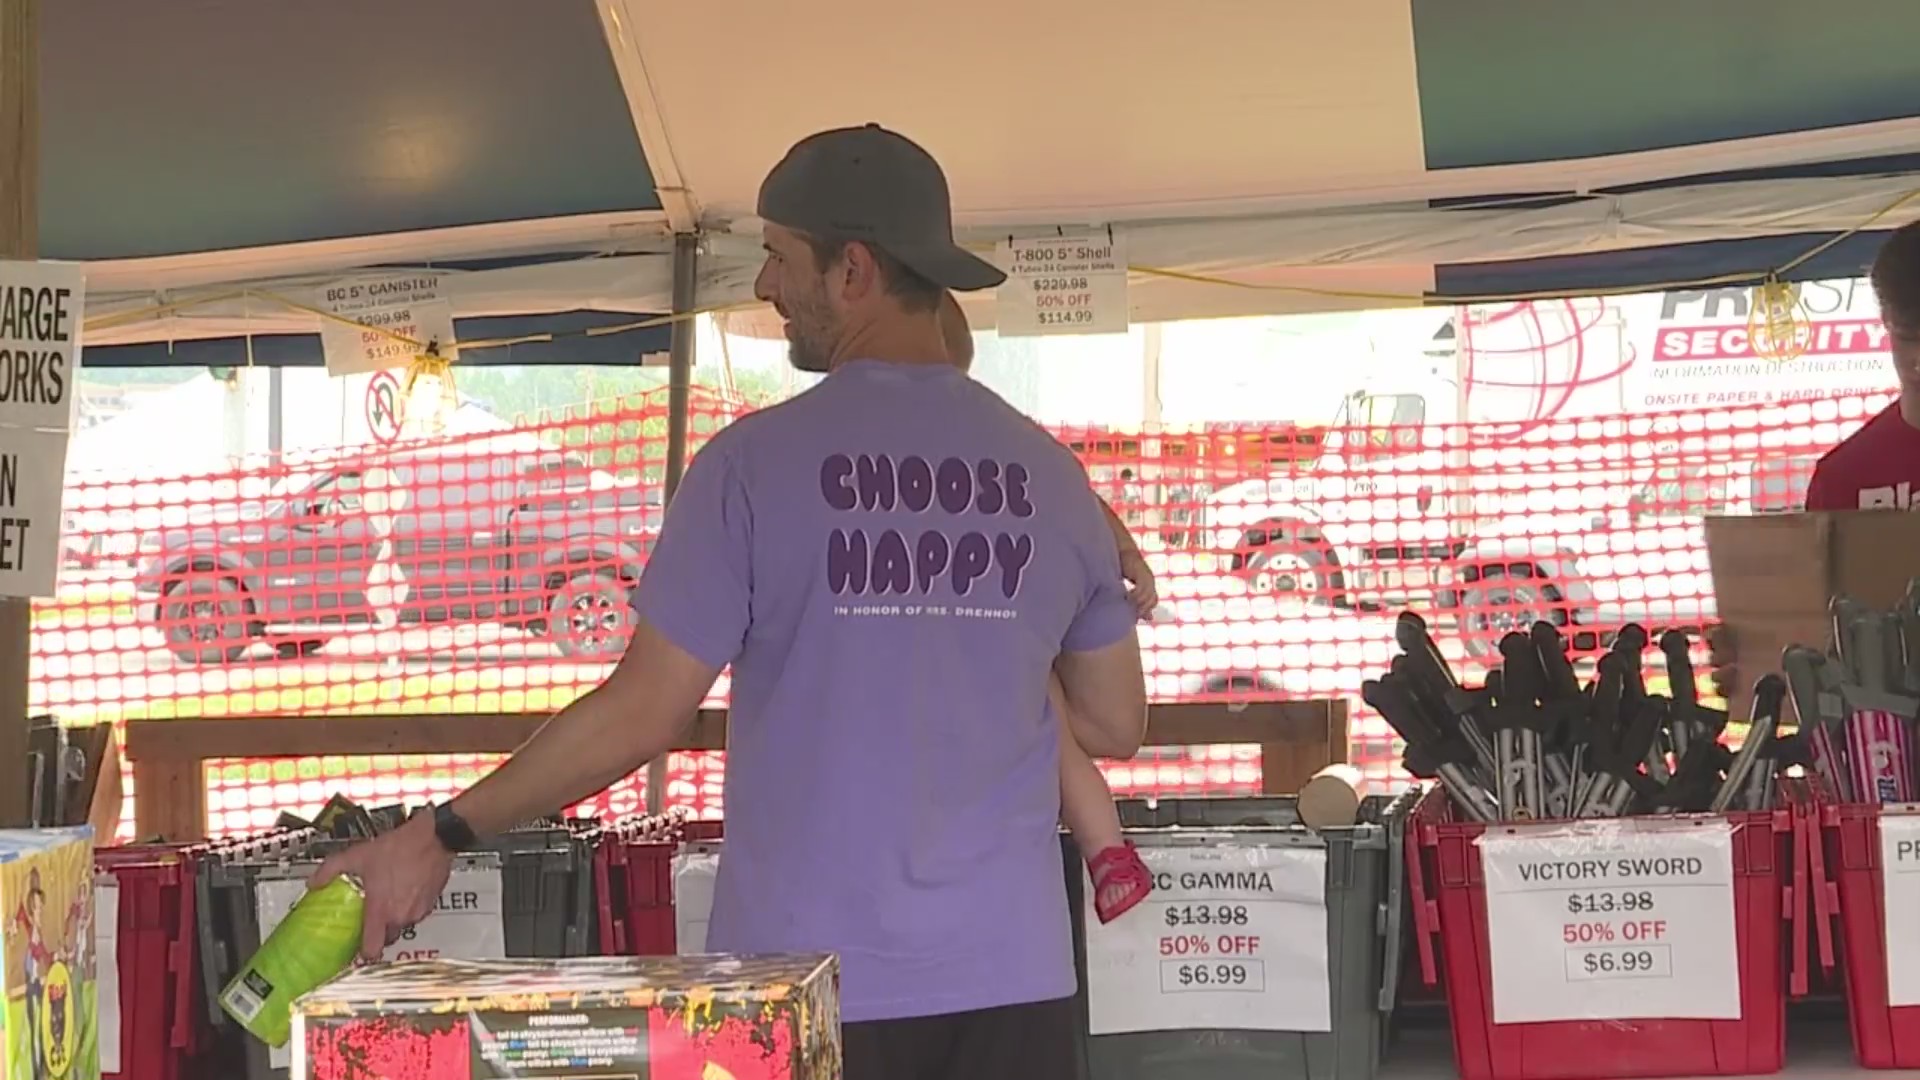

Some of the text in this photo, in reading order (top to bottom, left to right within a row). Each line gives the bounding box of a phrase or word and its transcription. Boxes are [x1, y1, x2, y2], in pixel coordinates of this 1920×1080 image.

[1014, 249, 1054, 262] T-800
[1076, 246, 1112, 260] Shell
[326, 287, 347, 302] BC
[368, 276, 438, 296] CANISTER
[1036, 293, 1092, 308] 50% OFF
[0, 286, 71, 342] ARGE
[1038, 310, 1093, 324] $114.99
[392, 324, 417, 341] OFF
[1661, 323, 1889, 358] SECURITY
[0, 349, 64, 405] ORKS
[1644, 393, 1700, 406] ONSITE
[1706, 391, 1759, 403] PAPER
[820, 453, 1036, 518] CHOOSE
[827, 528, 1035, 601] HAPPY
[833, 606, 848, 616] IN
[853, 606, 900, 616] HONOR
[905, 606, 922, 616] OF
[1518, 857, 1702, 881] VICTORY SWORD
[1180, 871, 1274, 892] GAMMA
[434, 891, 478, 910] LER
[1568, 891, 1654, 913] $13.98
[1165, 905, 1248, 926] $13.98
[1563, 920, 1666, 943] 50% OFF
[1159, 935, 1260, 956] 50% OFF
[1584, 949, 1653, 973] $6.99
[1179, 965, 1247, 985] $6.99
